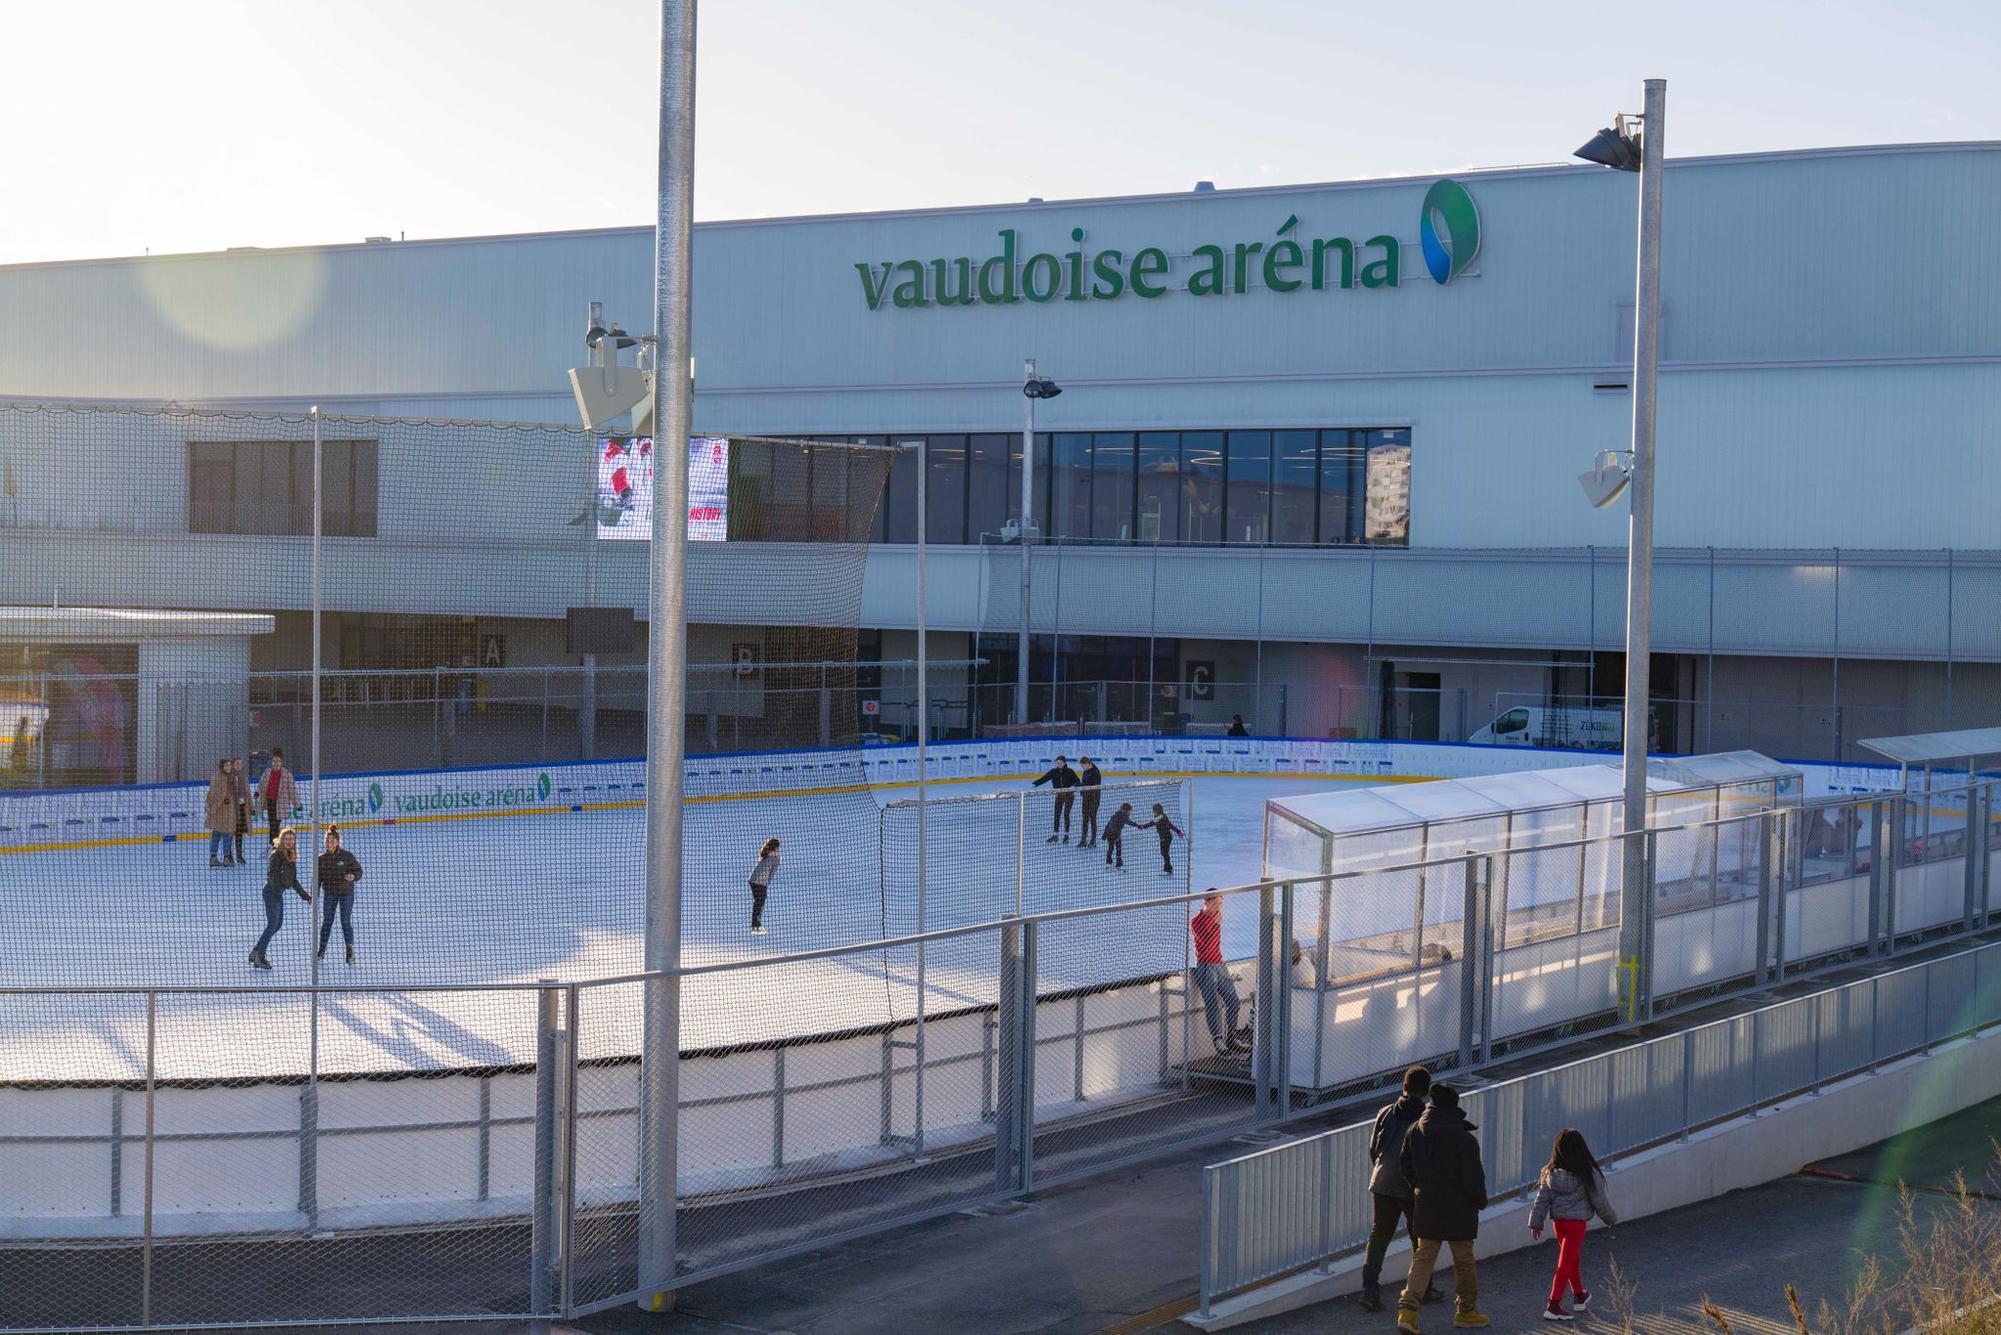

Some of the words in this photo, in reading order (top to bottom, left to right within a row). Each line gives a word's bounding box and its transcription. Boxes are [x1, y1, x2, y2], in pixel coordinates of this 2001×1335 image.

[855, 227, 1170, 310] vaudoise
[1188, 214, 1400, 295] aréna
[689, 507, 721, 521] HISTORY
[486, 637, 501, 664] A
[738, 648, 753, 674] B
[1193, 666, 1208, 695] C
[394, 785, 481, 812] vaudoise
[486, 783, 535, 806] aréna
